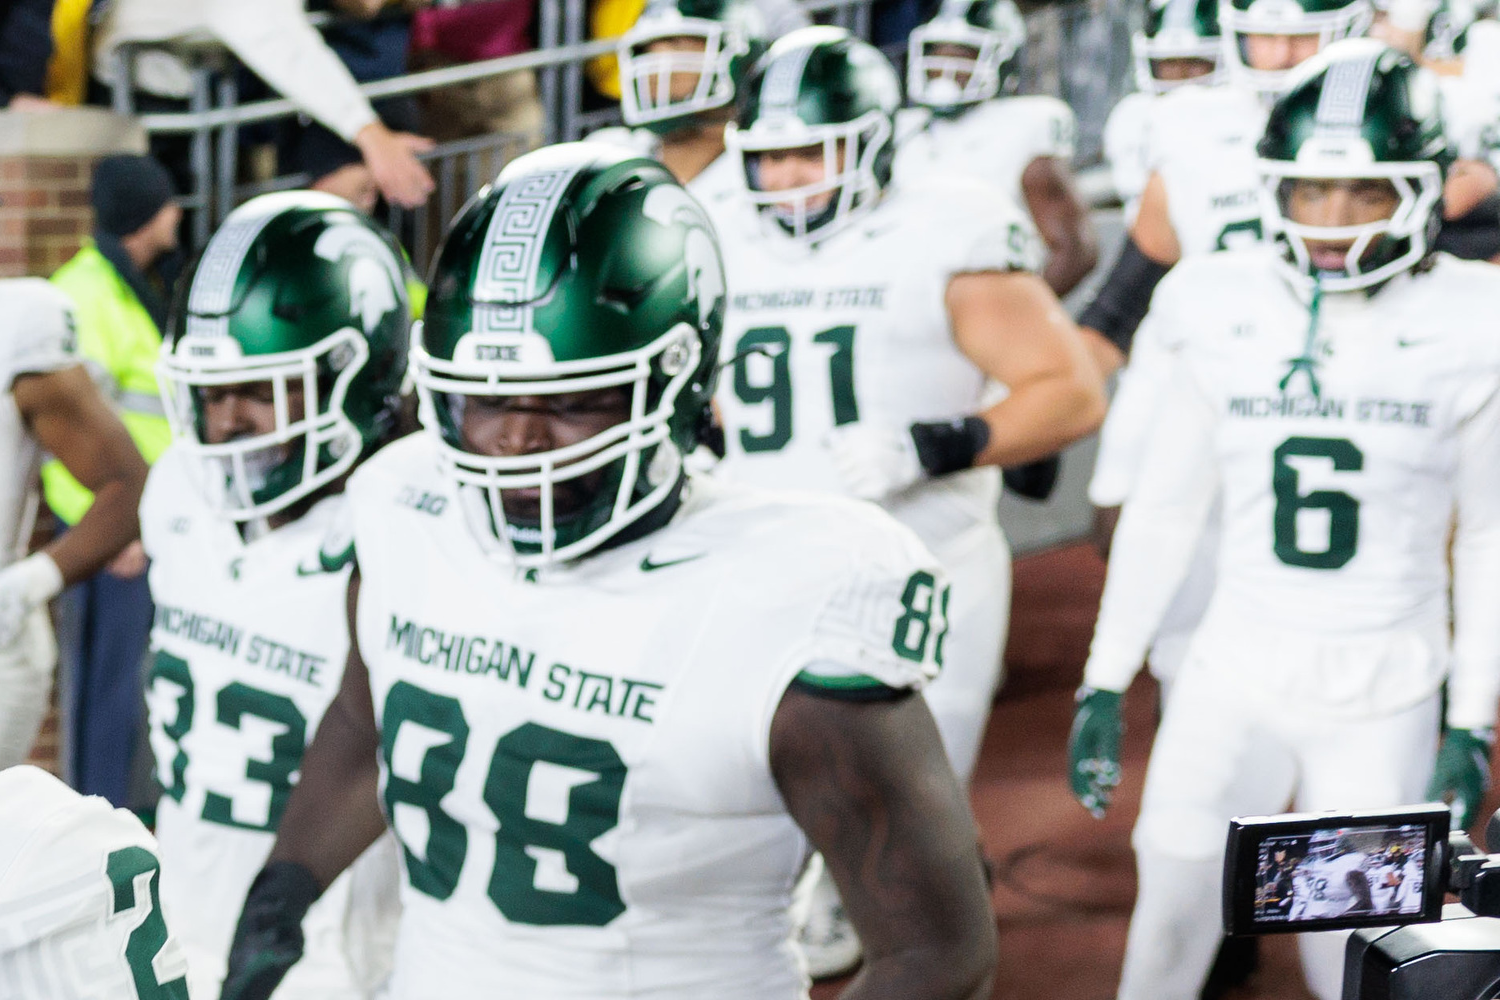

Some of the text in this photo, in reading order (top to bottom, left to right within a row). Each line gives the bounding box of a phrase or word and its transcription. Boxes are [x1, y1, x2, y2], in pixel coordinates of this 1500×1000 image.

[734, 325, 859, 454] 91
[1229, 396, 1431, 427] MICHIGAN STATE
[1273, 436, 1364, 570] 6
[246, 634, 327, 687] STATE
[386, 612, 666, 725] MICHIGAN STATE
[383, 679, 627, 928] 88
